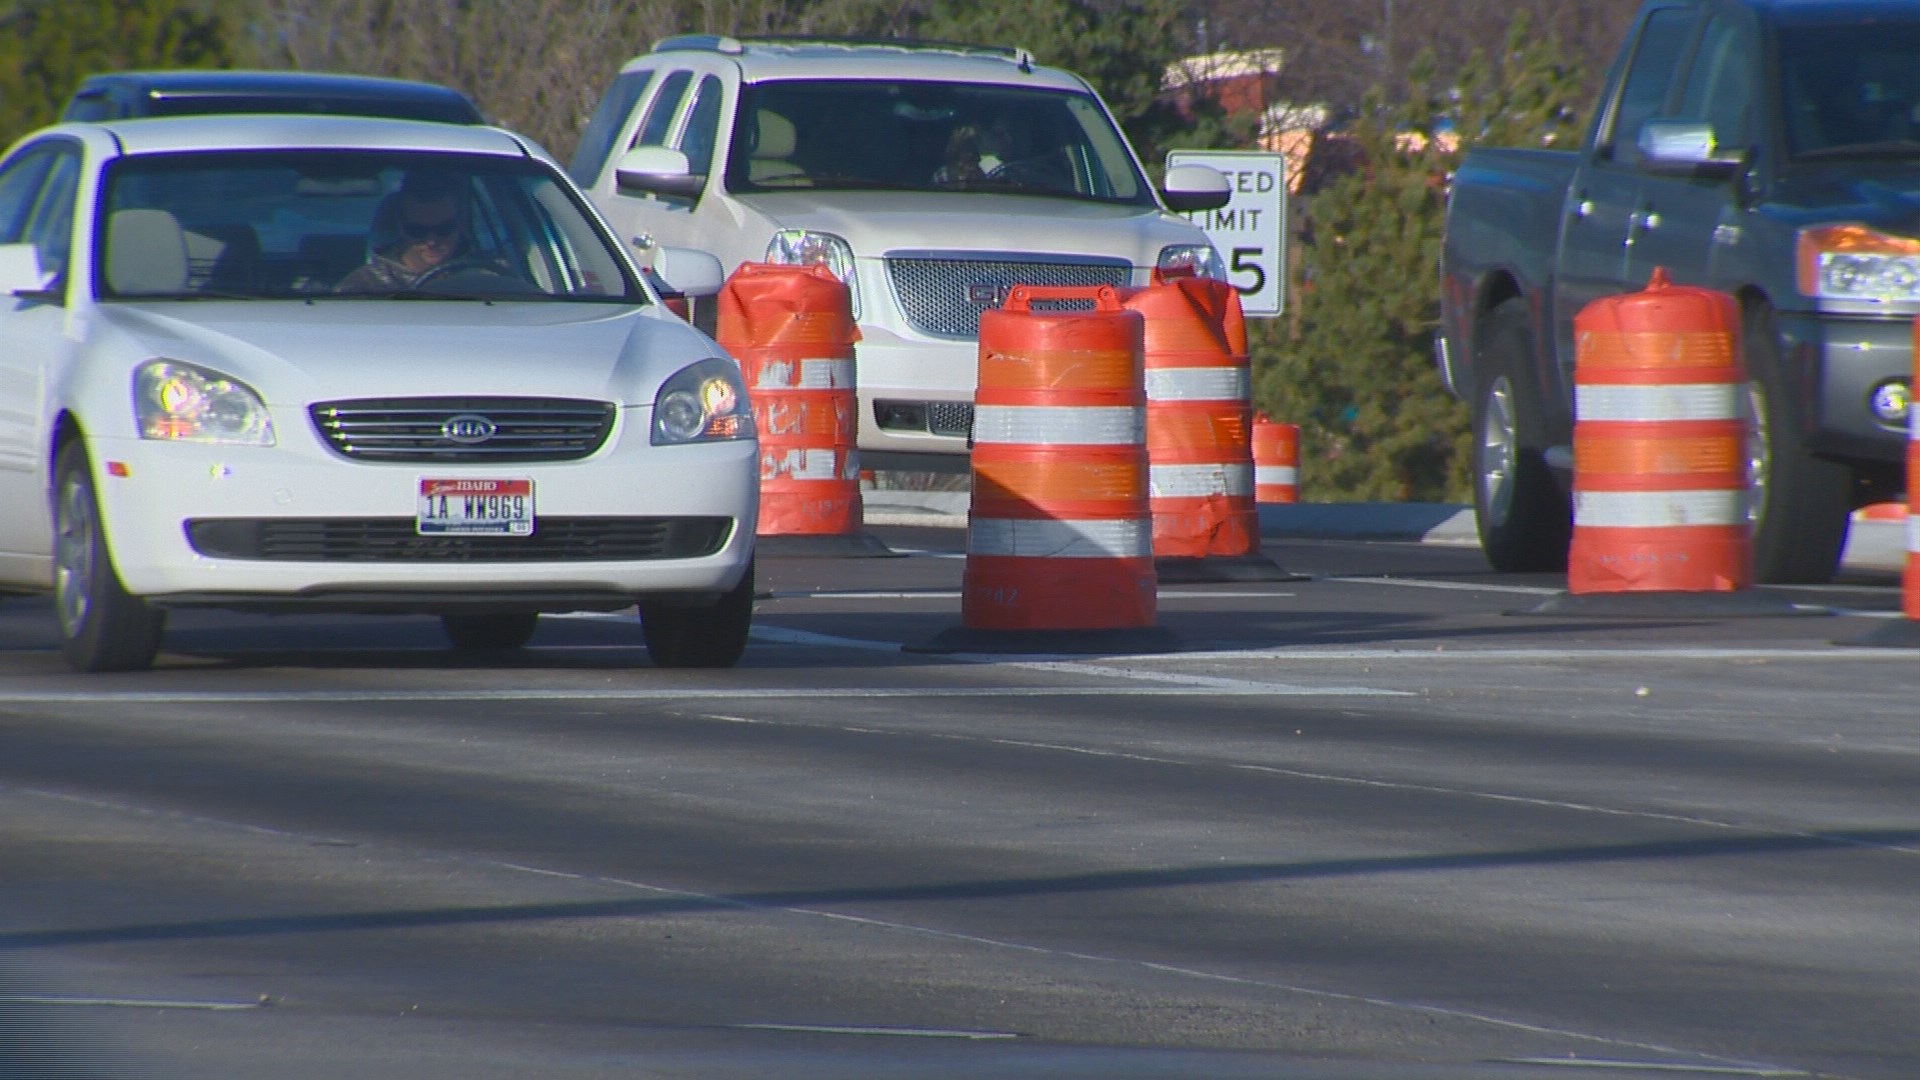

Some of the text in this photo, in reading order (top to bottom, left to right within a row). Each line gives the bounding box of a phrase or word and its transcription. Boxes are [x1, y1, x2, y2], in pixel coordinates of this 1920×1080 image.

[1231, 247, 1266, 296] 5
[452, 421, 487, 436] KIA
[456, 480, 497, 491] IDAHO
[426, 494, 449, 519] 1A
